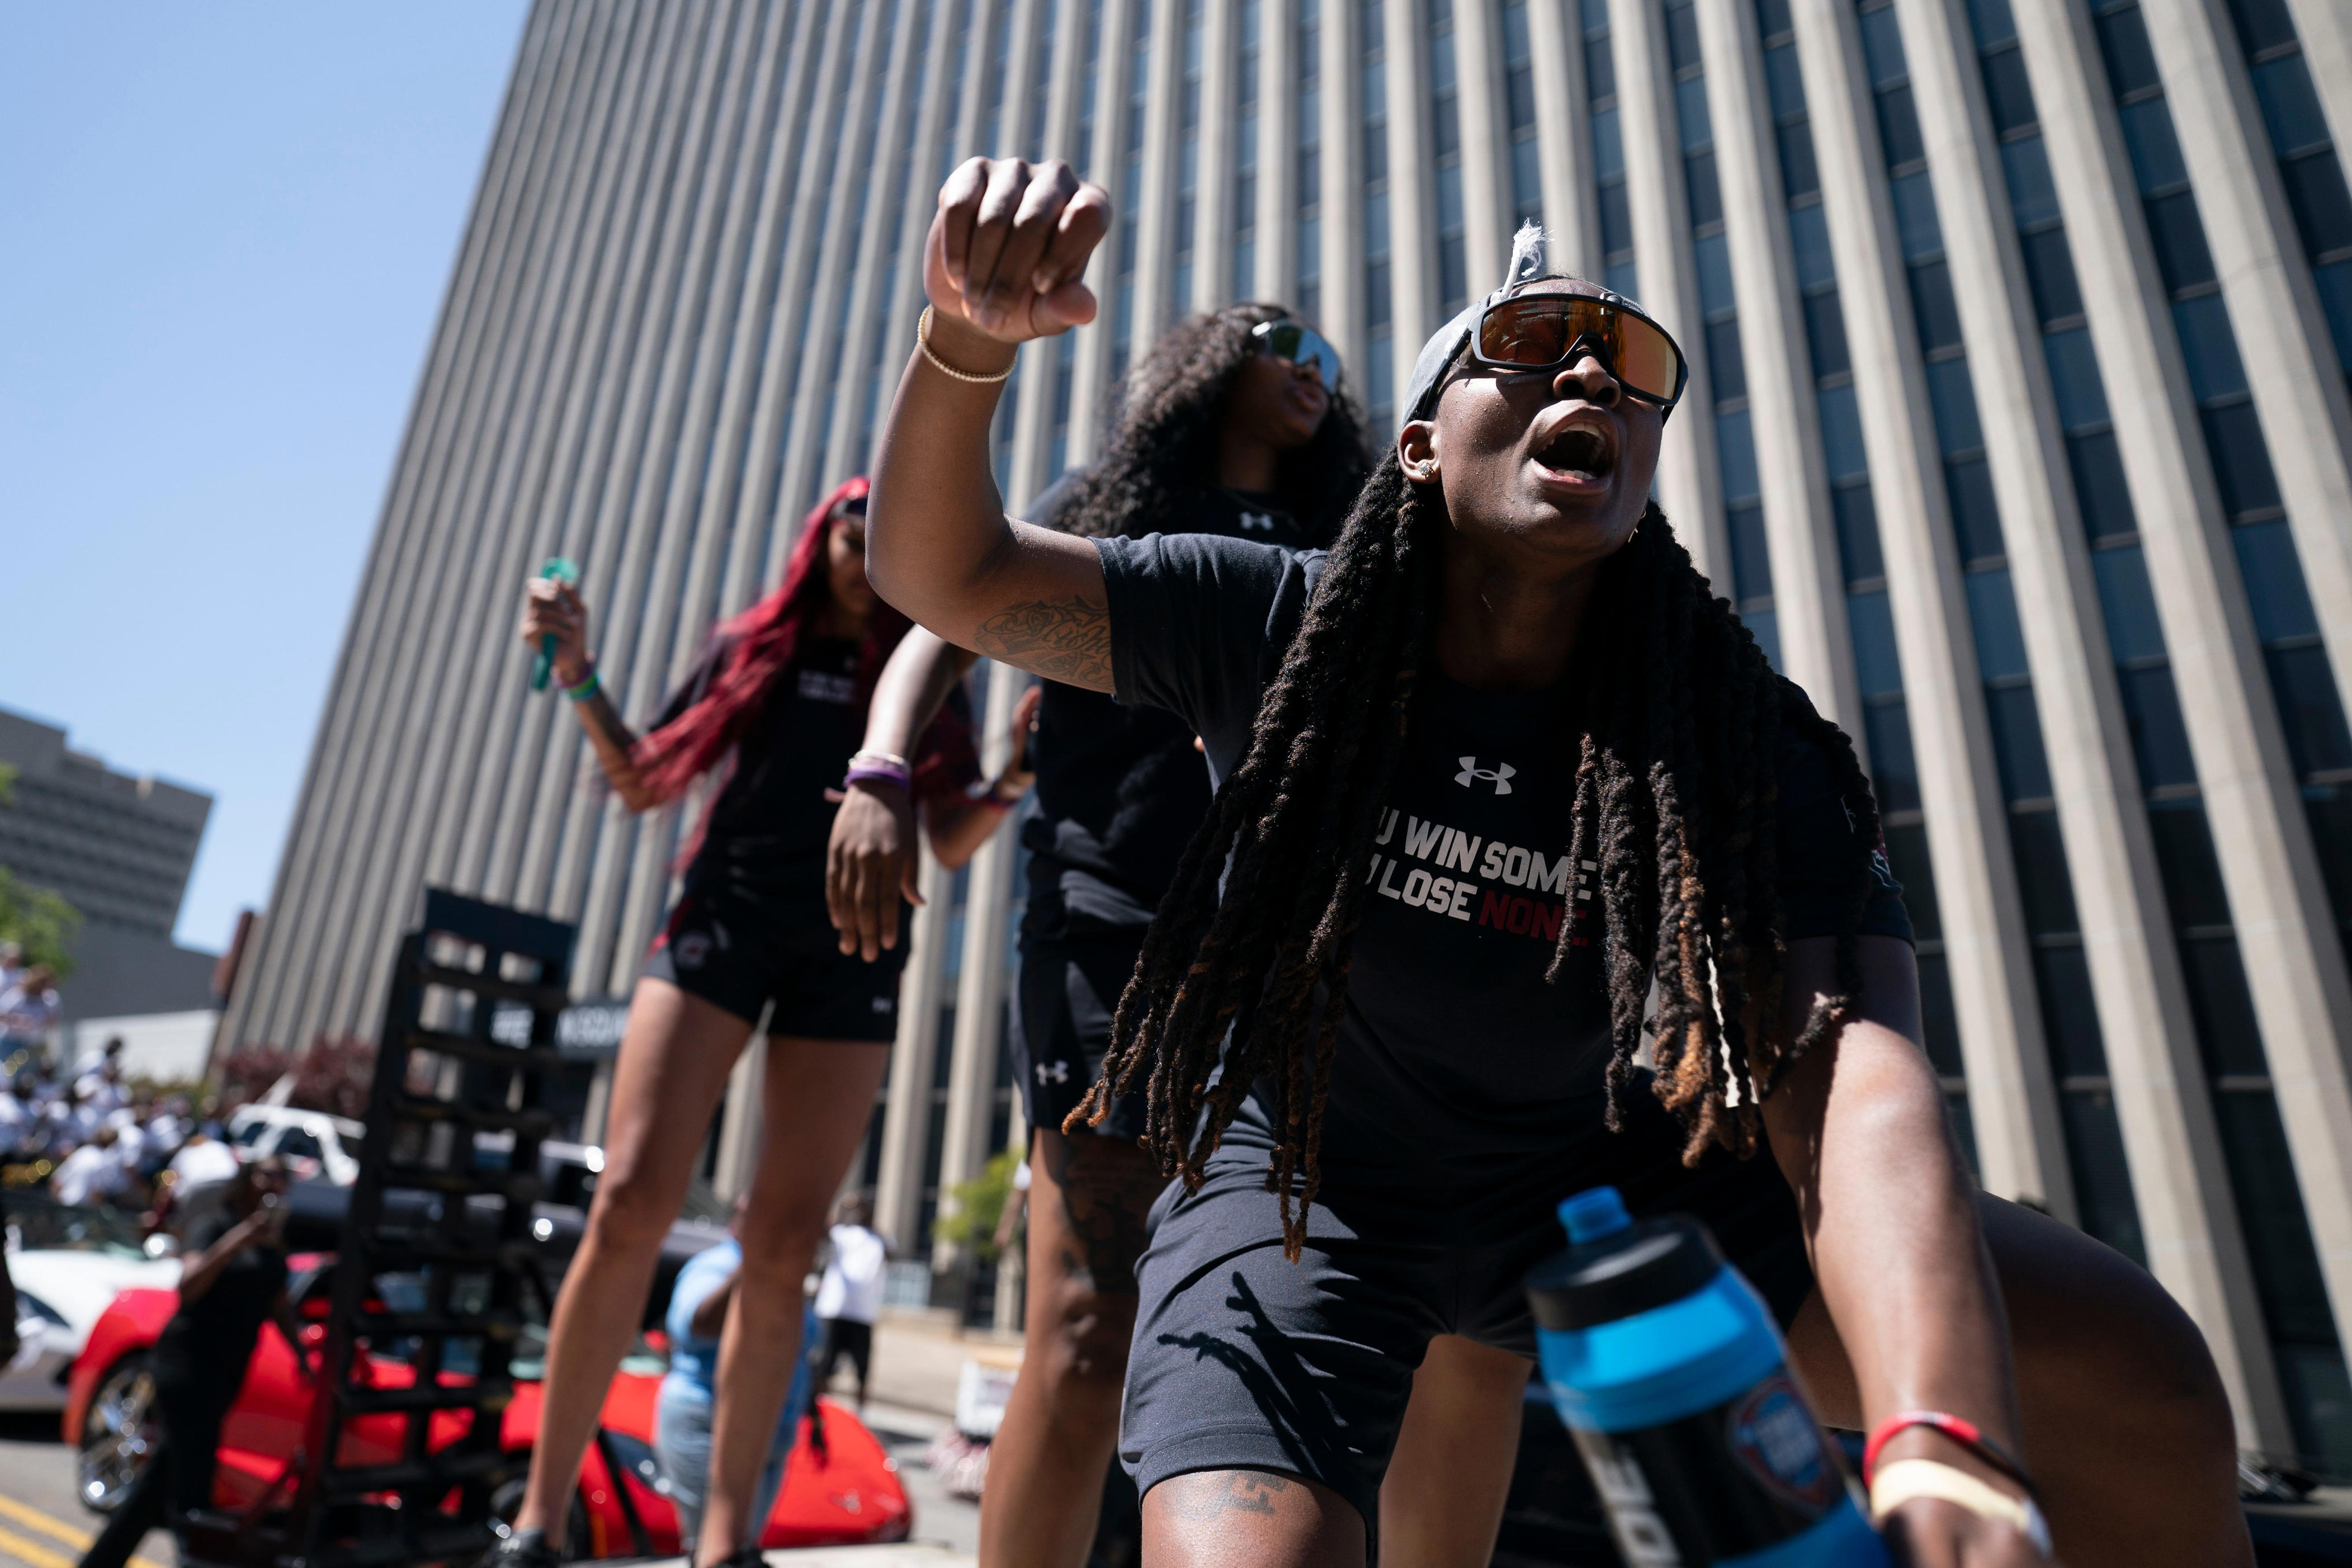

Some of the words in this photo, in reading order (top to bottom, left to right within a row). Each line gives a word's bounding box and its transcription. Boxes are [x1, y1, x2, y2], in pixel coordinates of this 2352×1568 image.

[1377, 858, 1478, 922] LOSE
[1404, 815, 1482, 873] WIN
[1479, 840, 1598, 901] SOME
